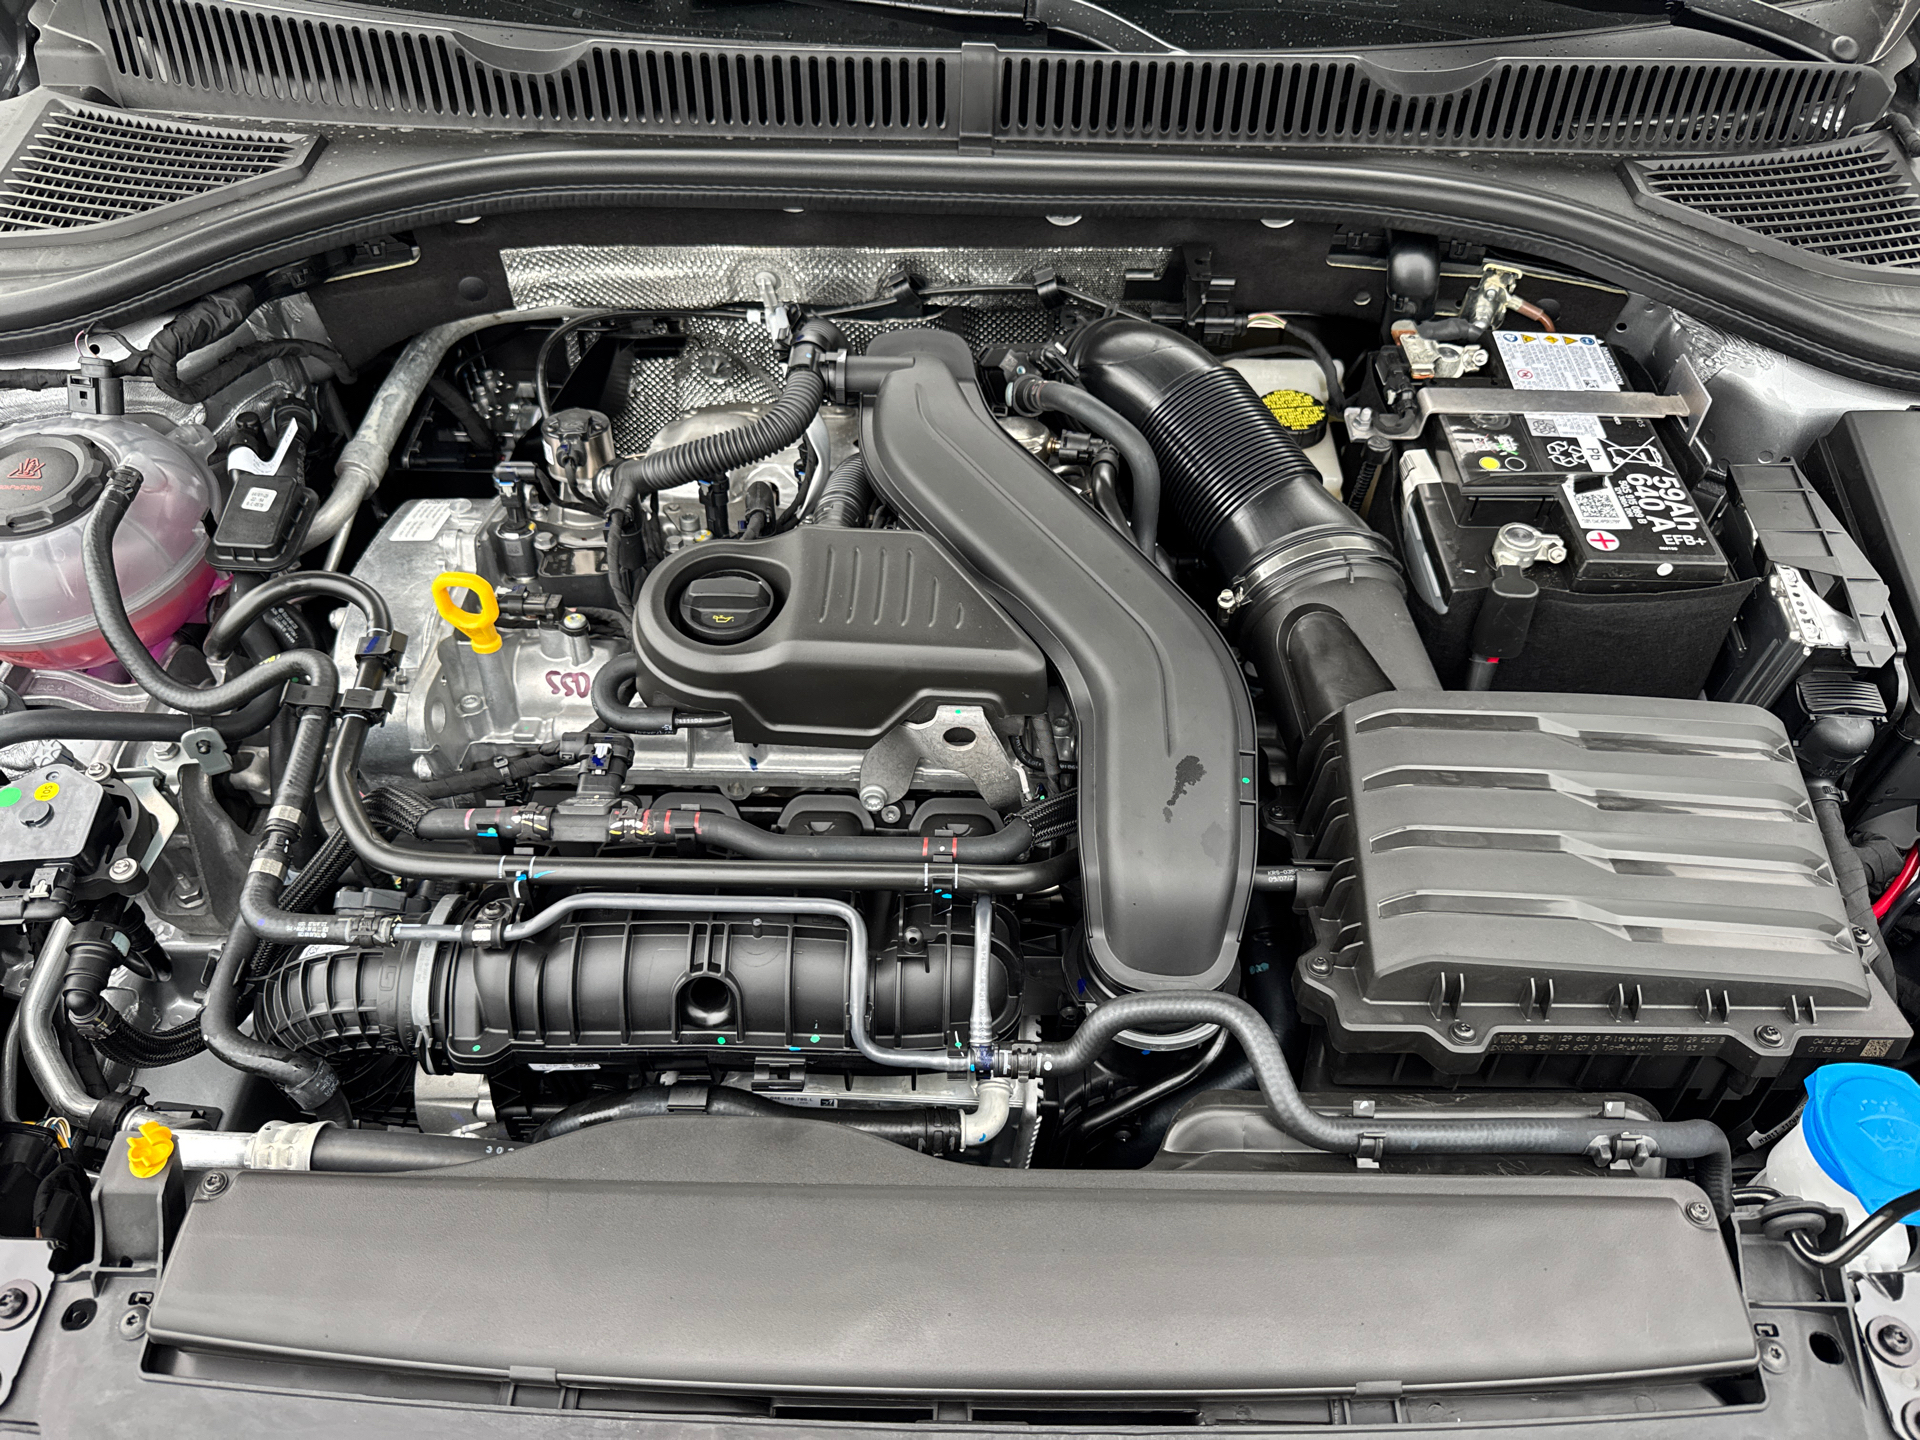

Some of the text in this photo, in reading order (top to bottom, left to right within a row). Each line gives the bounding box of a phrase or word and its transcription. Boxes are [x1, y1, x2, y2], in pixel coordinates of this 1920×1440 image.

[1586, 447, 1602, 461] Pb
[1626, 473, 1666, 511] 640
[1652, 475, 1700, 531] 59Ah
[1645, 515, 1676, 533] A
[1662, 534, 1707, 546] EFB+
[1603, 1035, 1661, 1043] Filterelement
